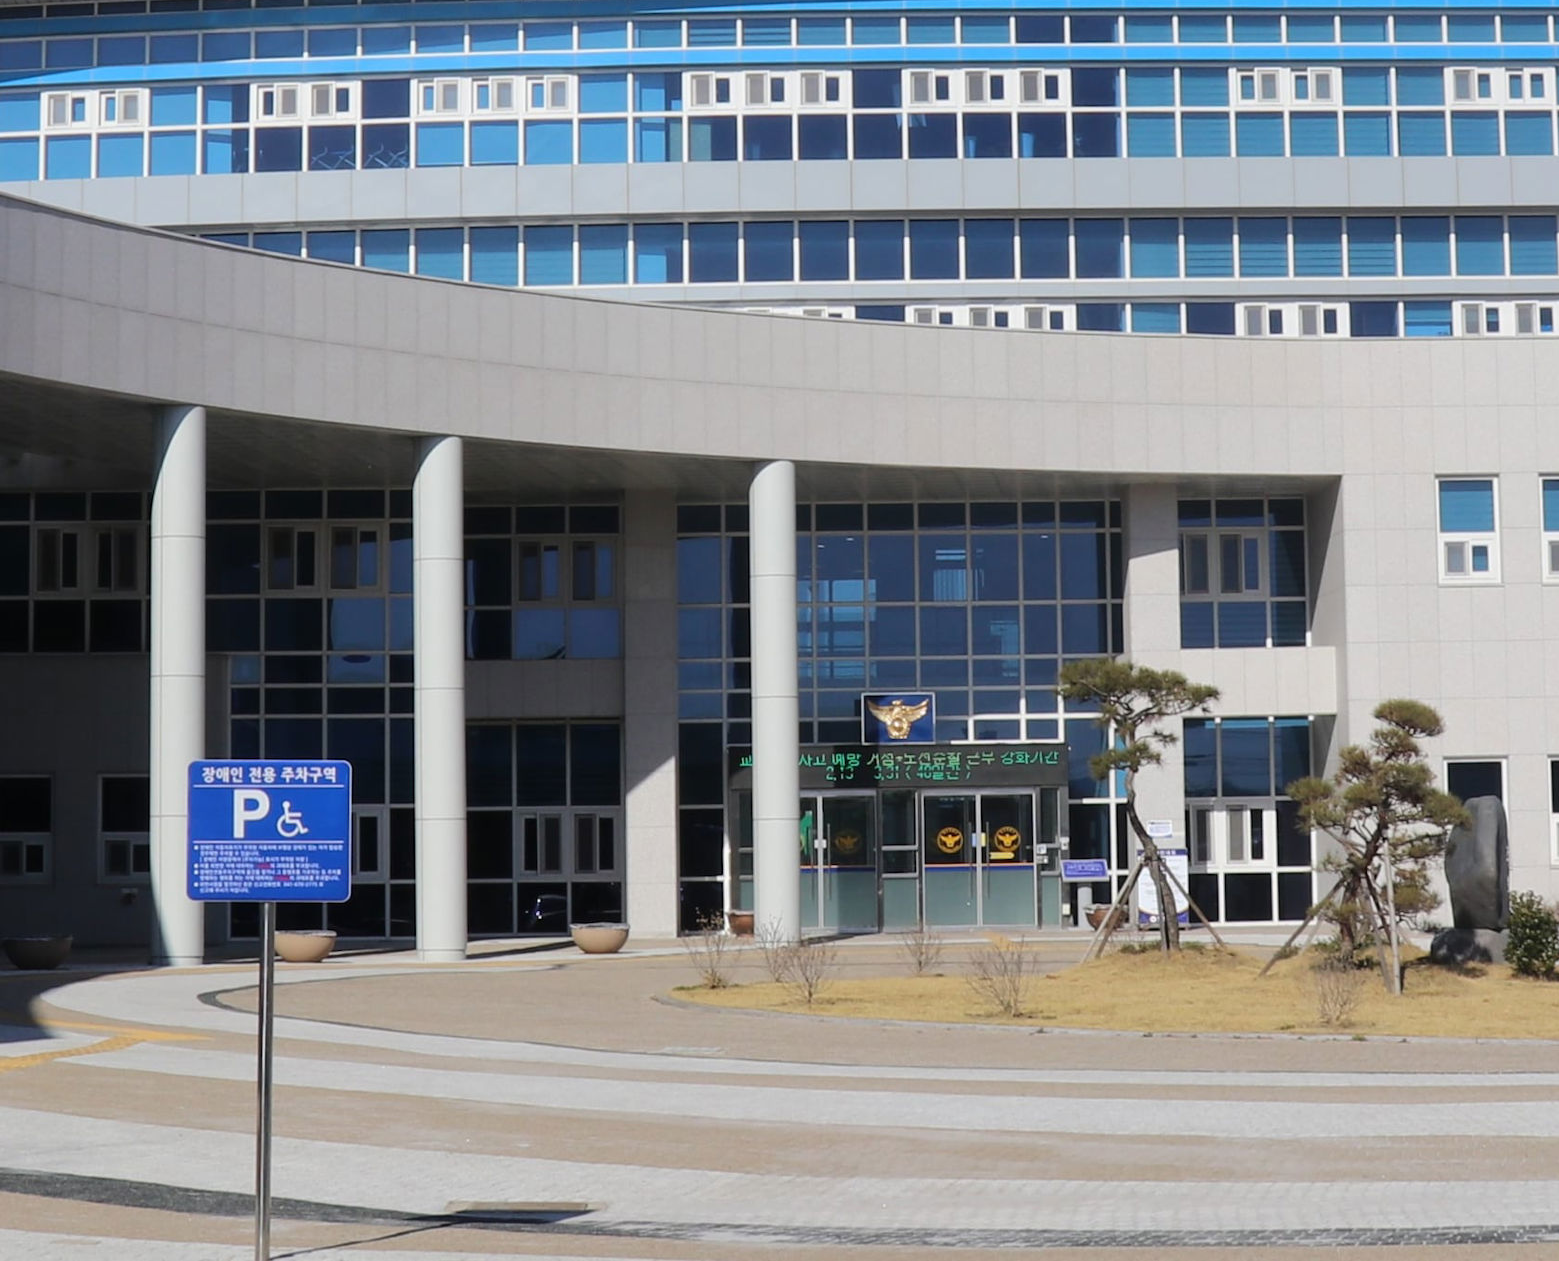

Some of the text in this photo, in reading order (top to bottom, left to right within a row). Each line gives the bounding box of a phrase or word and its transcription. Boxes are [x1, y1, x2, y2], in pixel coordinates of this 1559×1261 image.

[201, 766, 337, 784] 장애인 전용 주차구역
[234, 789, 271, 839] P
